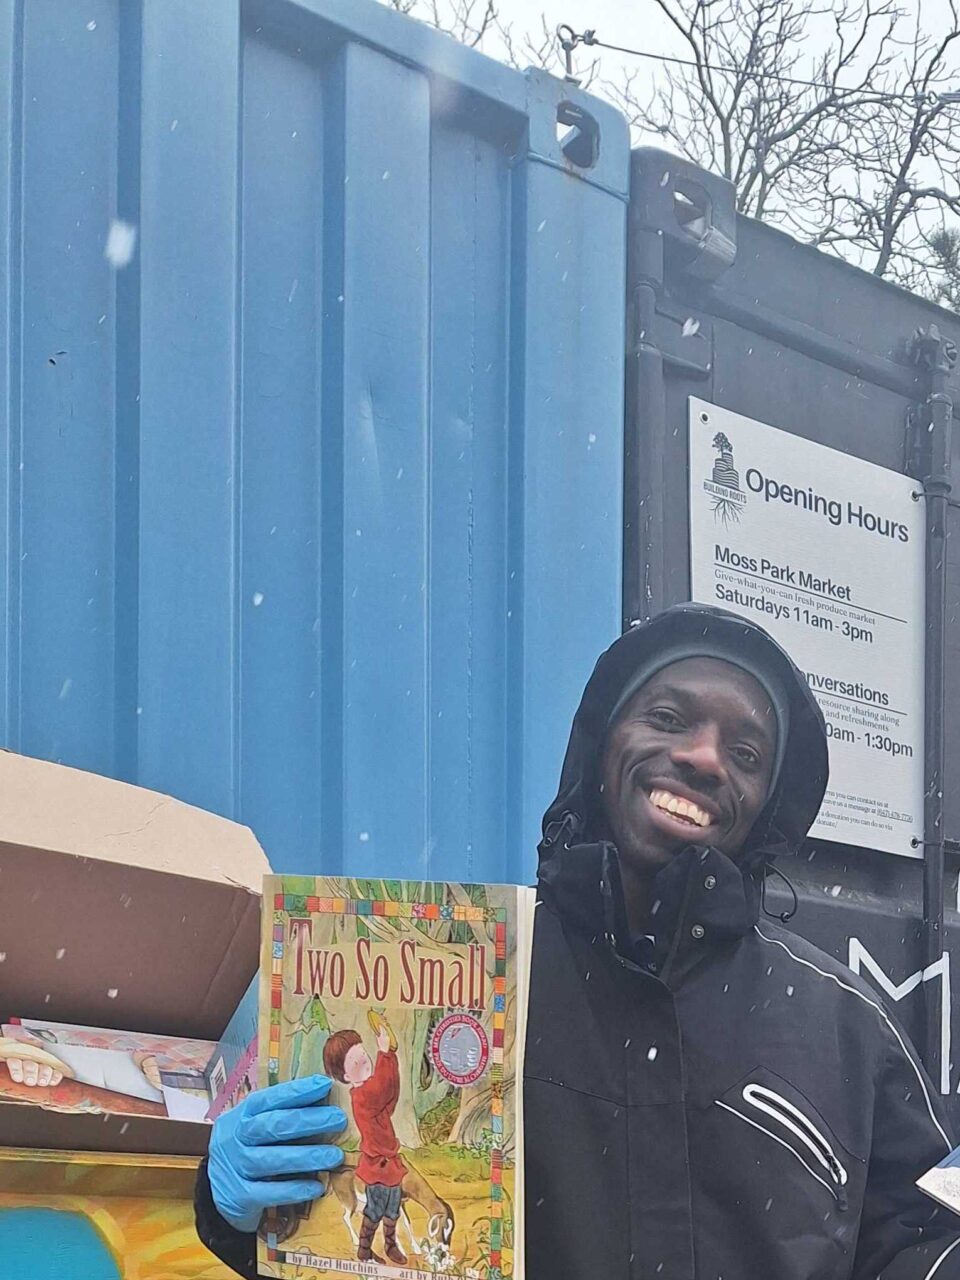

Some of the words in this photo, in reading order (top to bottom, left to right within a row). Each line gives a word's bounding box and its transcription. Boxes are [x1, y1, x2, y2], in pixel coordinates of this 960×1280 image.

[745, 468, 841, 525] Opening
[848, 502, 909, 542] Hours
[714, 569, 793, 600] Give-what-you-can
[795, 593, 815, 608] fresh
[816, 600, 848, 617] produce
[849, 609, 876, 625] market
[715, 544, 757, 572] Moss
[761, 559, 795, 584] Park
[800, 571, 851, 601] Market
[715, 583, 790, 619] Saturdays
[793, 607, 833, 631] 11am
[842, 621, 873, 643] 3pm
[825, 709, 840, 720] and
[841, 713, 889, 732] refreshments
[852, 706, 879, 722] sharing
[880, 712, 901, 727] along
[865, 733, 913, 757] 1:30pm
[289, 917, 345, 999] Two
[355, 937, 390, 1002] So
[400, 939, 487, 1011] Small
[292, 1253, 303, 1266] by
[306, 1254, 333, 1270] Hazel
[335, 1259, 379, 1275] Hutchins
[399, 1269, 414, 1280] art
